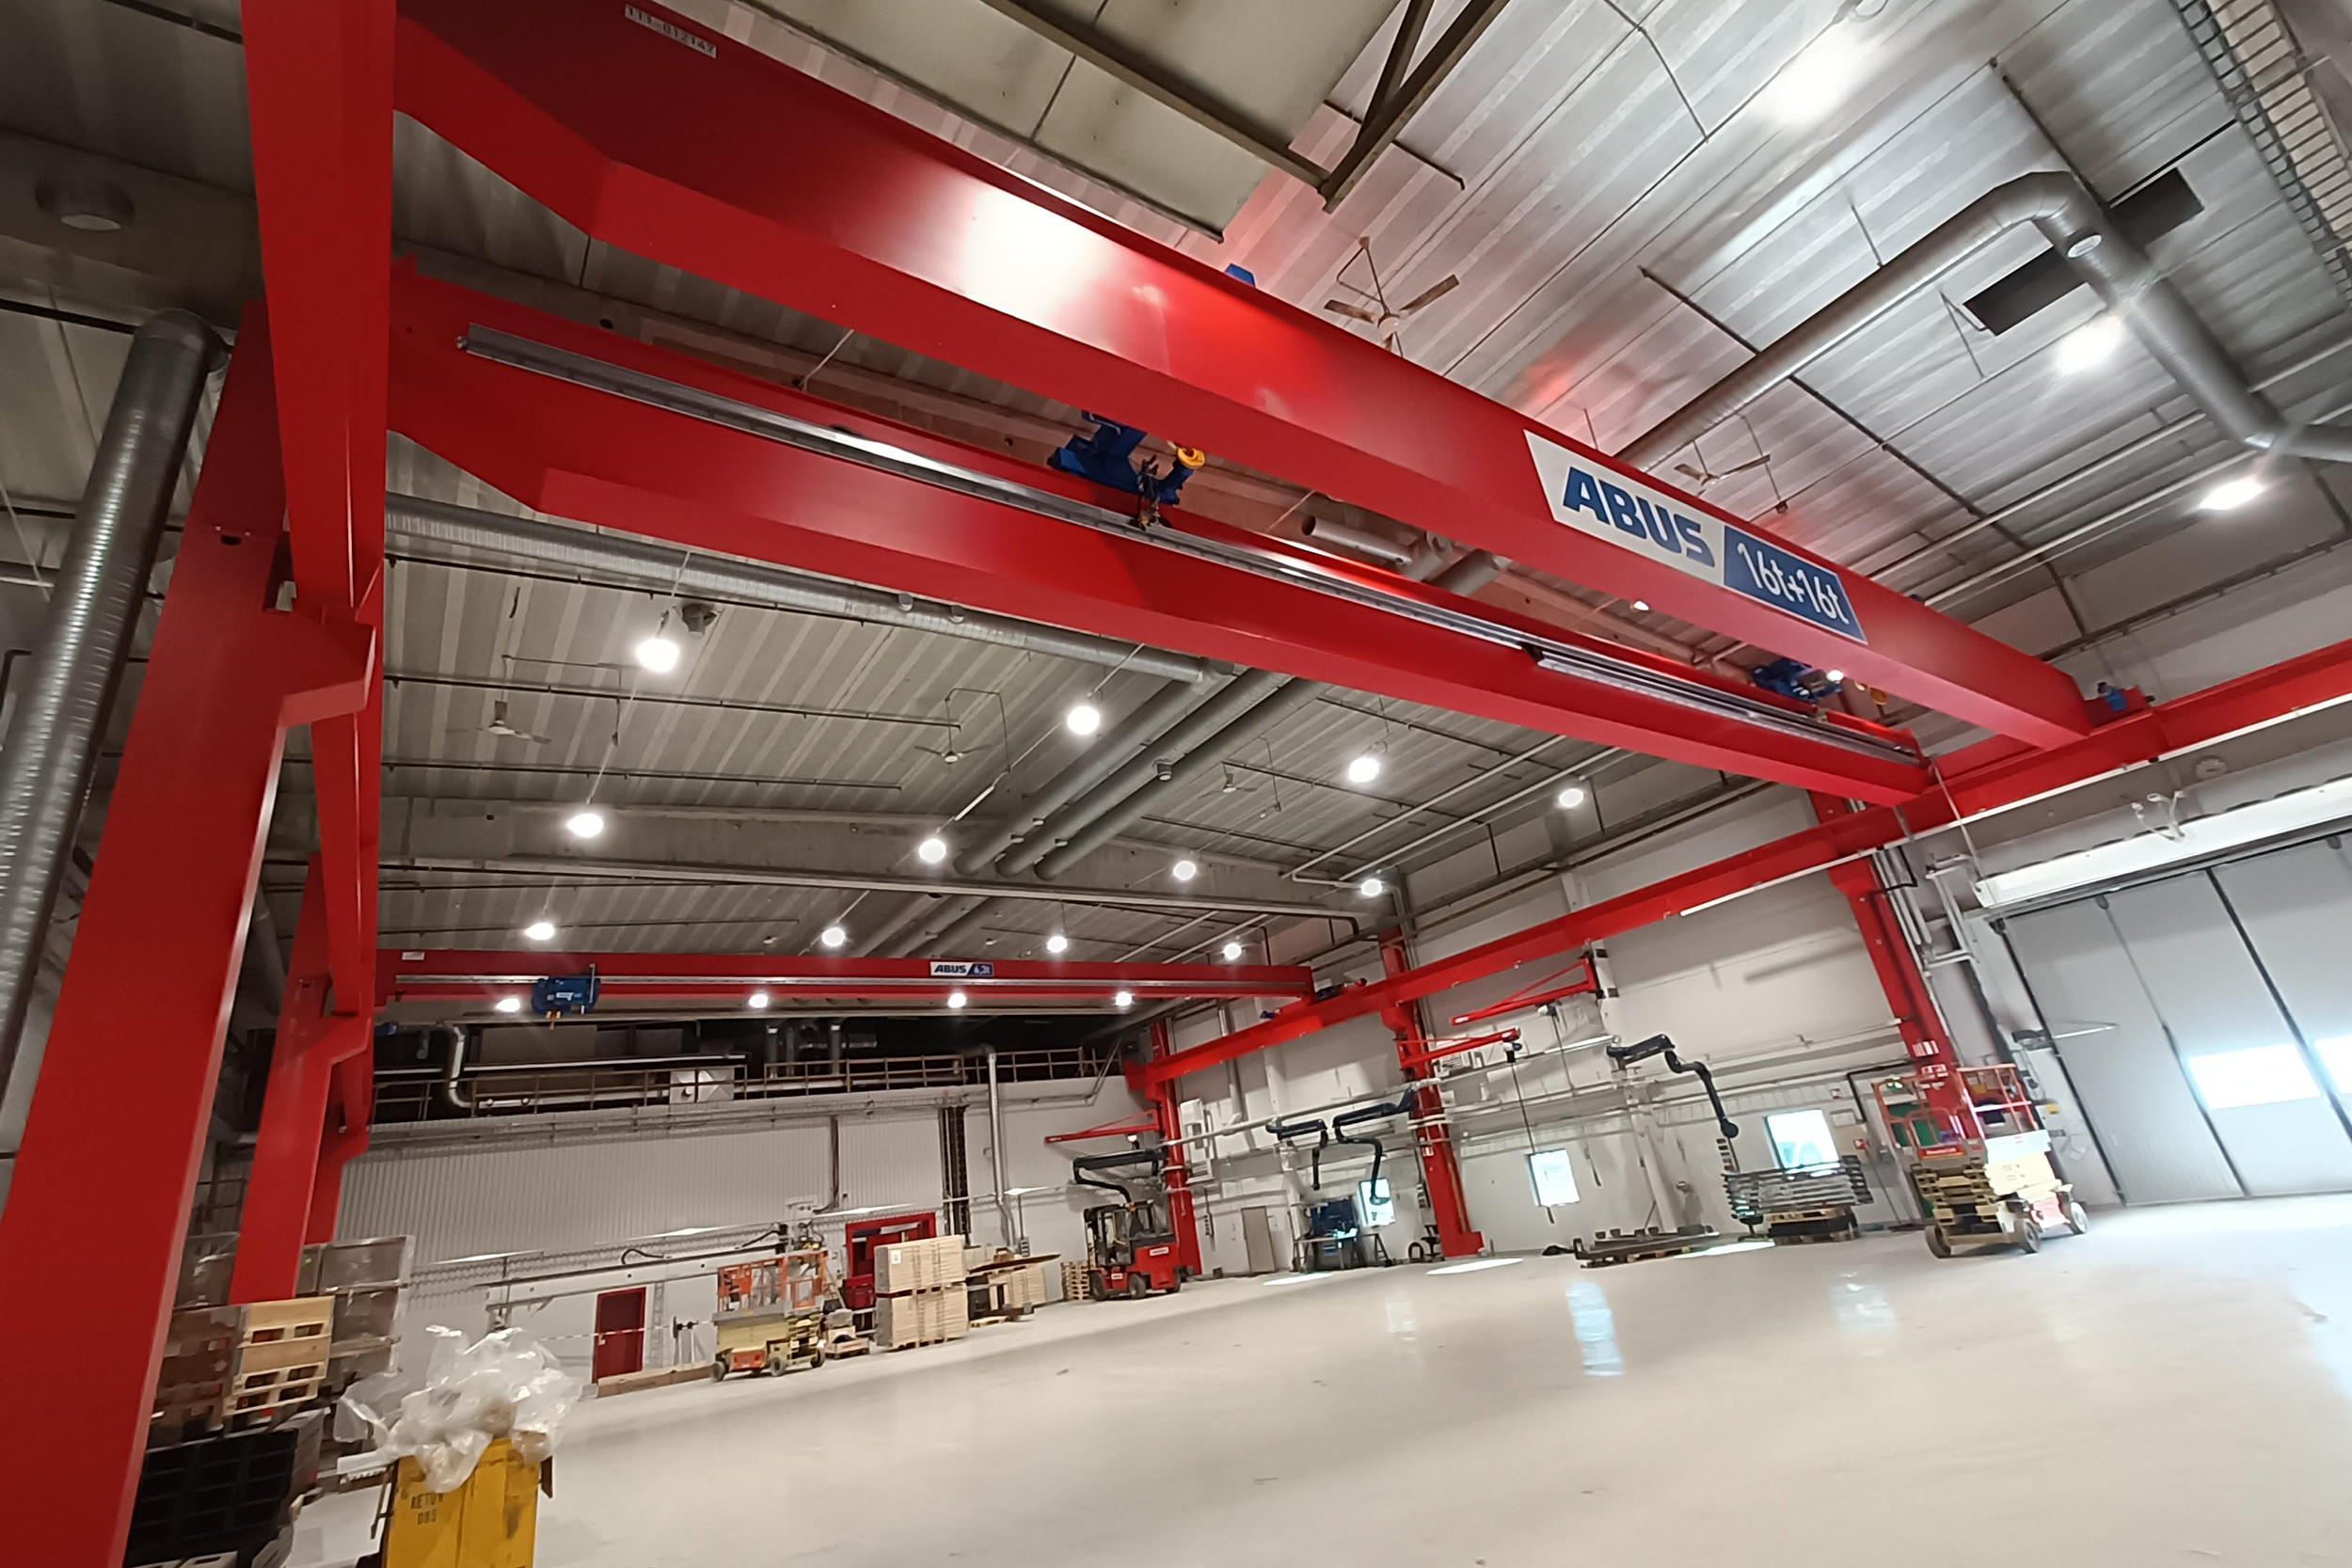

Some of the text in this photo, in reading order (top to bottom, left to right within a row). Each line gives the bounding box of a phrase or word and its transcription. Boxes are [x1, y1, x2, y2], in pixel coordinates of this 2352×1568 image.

[1563, 466, 1850, 625] ABUS 16t+16t
[934, 964, 967, 974] ABUS
